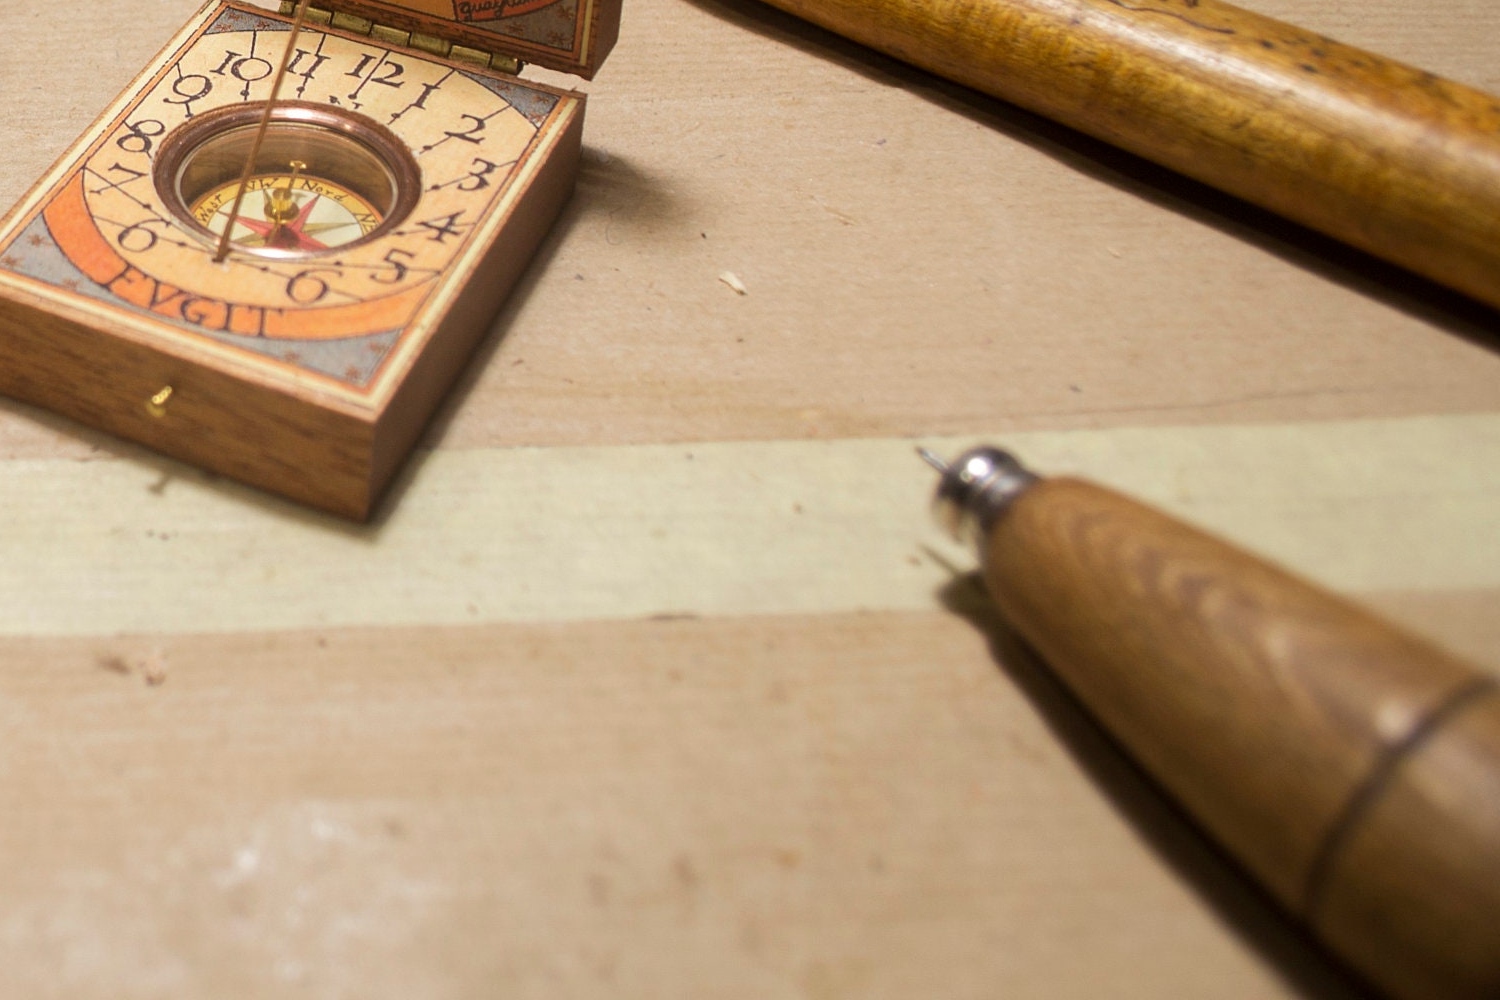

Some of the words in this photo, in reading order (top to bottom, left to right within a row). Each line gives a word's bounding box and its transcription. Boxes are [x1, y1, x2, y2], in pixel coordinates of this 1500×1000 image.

[210, 50, 273, 82] 10
[345, 53, 405, 88] 12
[163, 74, 213, 104] 9
[116, 119, 166, 152] 8
[444, 114, 486, 145] 2
[300, 180, 348, 201] Nord
[457, 157, 497, 191] 3
[118, 218, 172, 252] 6
[416, 210, 467, 243] 4
[369, 248, 416, 284] 5
[98, 264, 285, 337] FVGIT
[286, 267, 344, 303] 6
